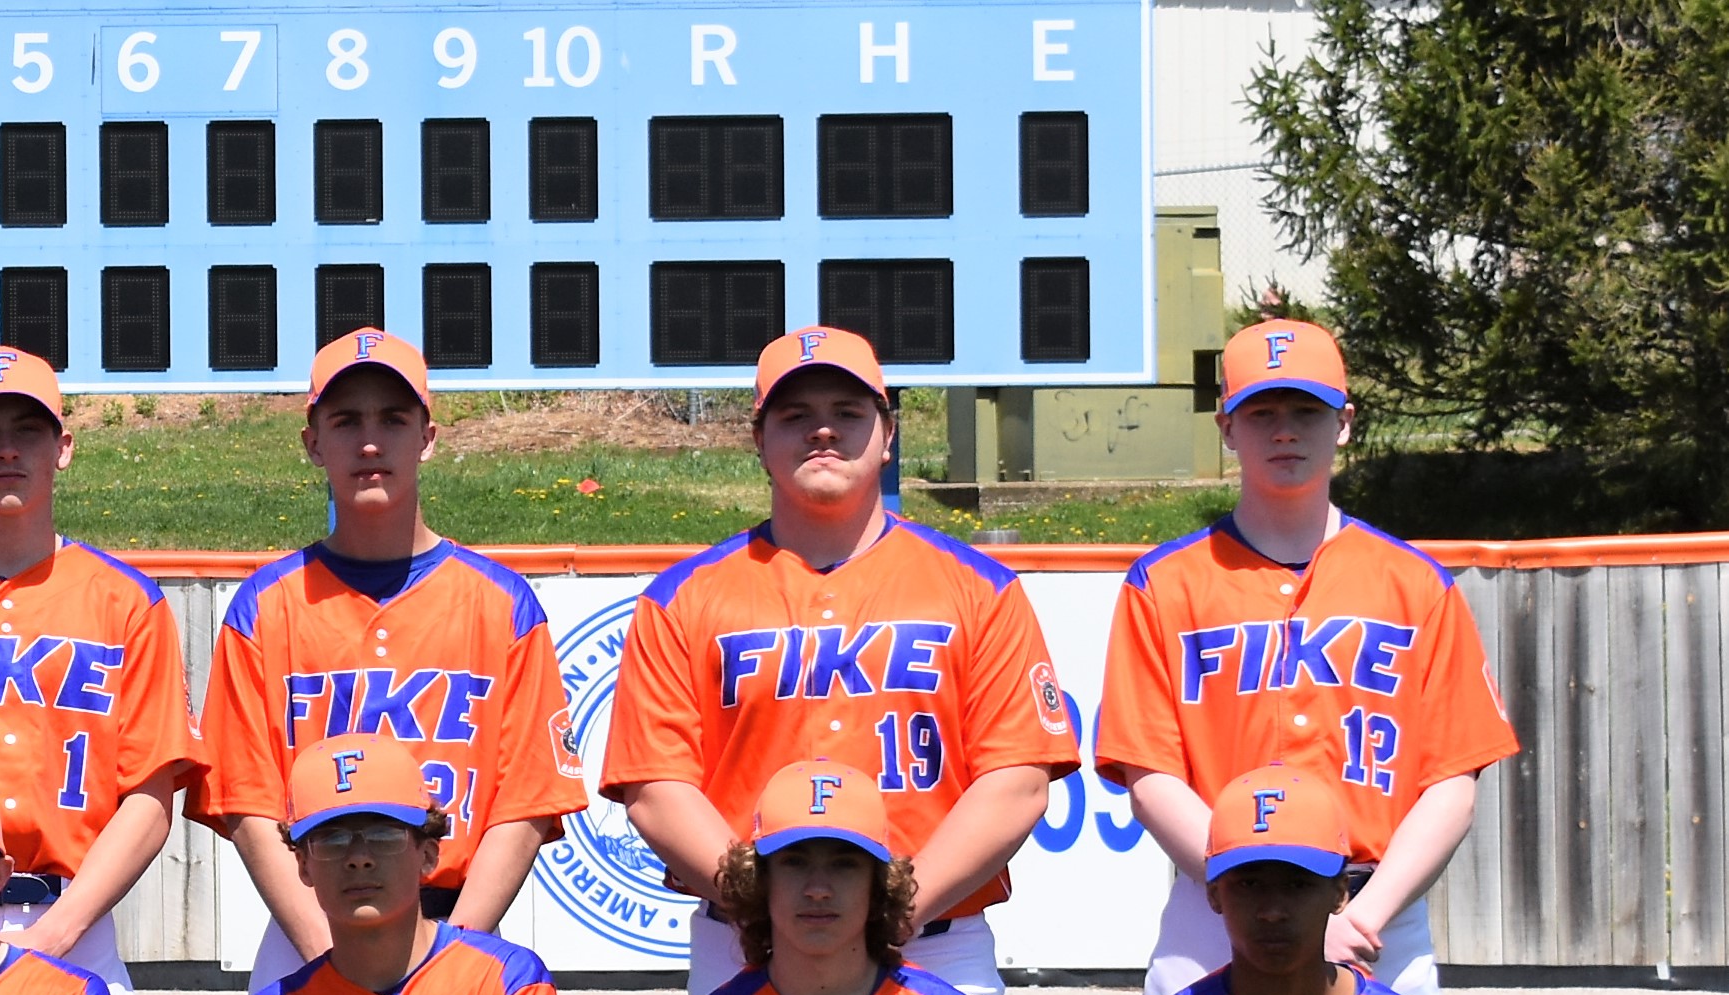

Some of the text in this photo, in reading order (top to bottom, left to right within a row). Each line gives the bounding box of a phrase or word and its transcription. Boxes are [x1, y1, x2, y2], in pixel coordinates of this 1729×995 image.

[11, 32, 55, 94] 5
[116, 31, 161, 93] 6
[220, 30, 263, 92] 7
[325, 28, 369, 91] 8
[433, 27, 477, 89] 9
[523, 25, 602, 89] 10
[691, 24, 738, 86] R
[859, 21, 910, 84] H
[1033, 19, 1075, 82] E
[354, 332, 384, 360] F
[798, 332, 827, 361] F
[1265, 331, 1294, 369] F
[716, 620, 957, 708] FIKE
[1179, 616, 1418, 704] FIKE
[282, 668, 495, 748] FIKE
[57, 732, 89, 811] 1
[331, 749, 364, 792] F
[875, 711, 942, 792] 19
[1341, 704, 1401, 797] 12
[809, 774, 842, 815] F
[1252, 787, 1284, 832] F
[551, 842, 659, 929] AMERIC
